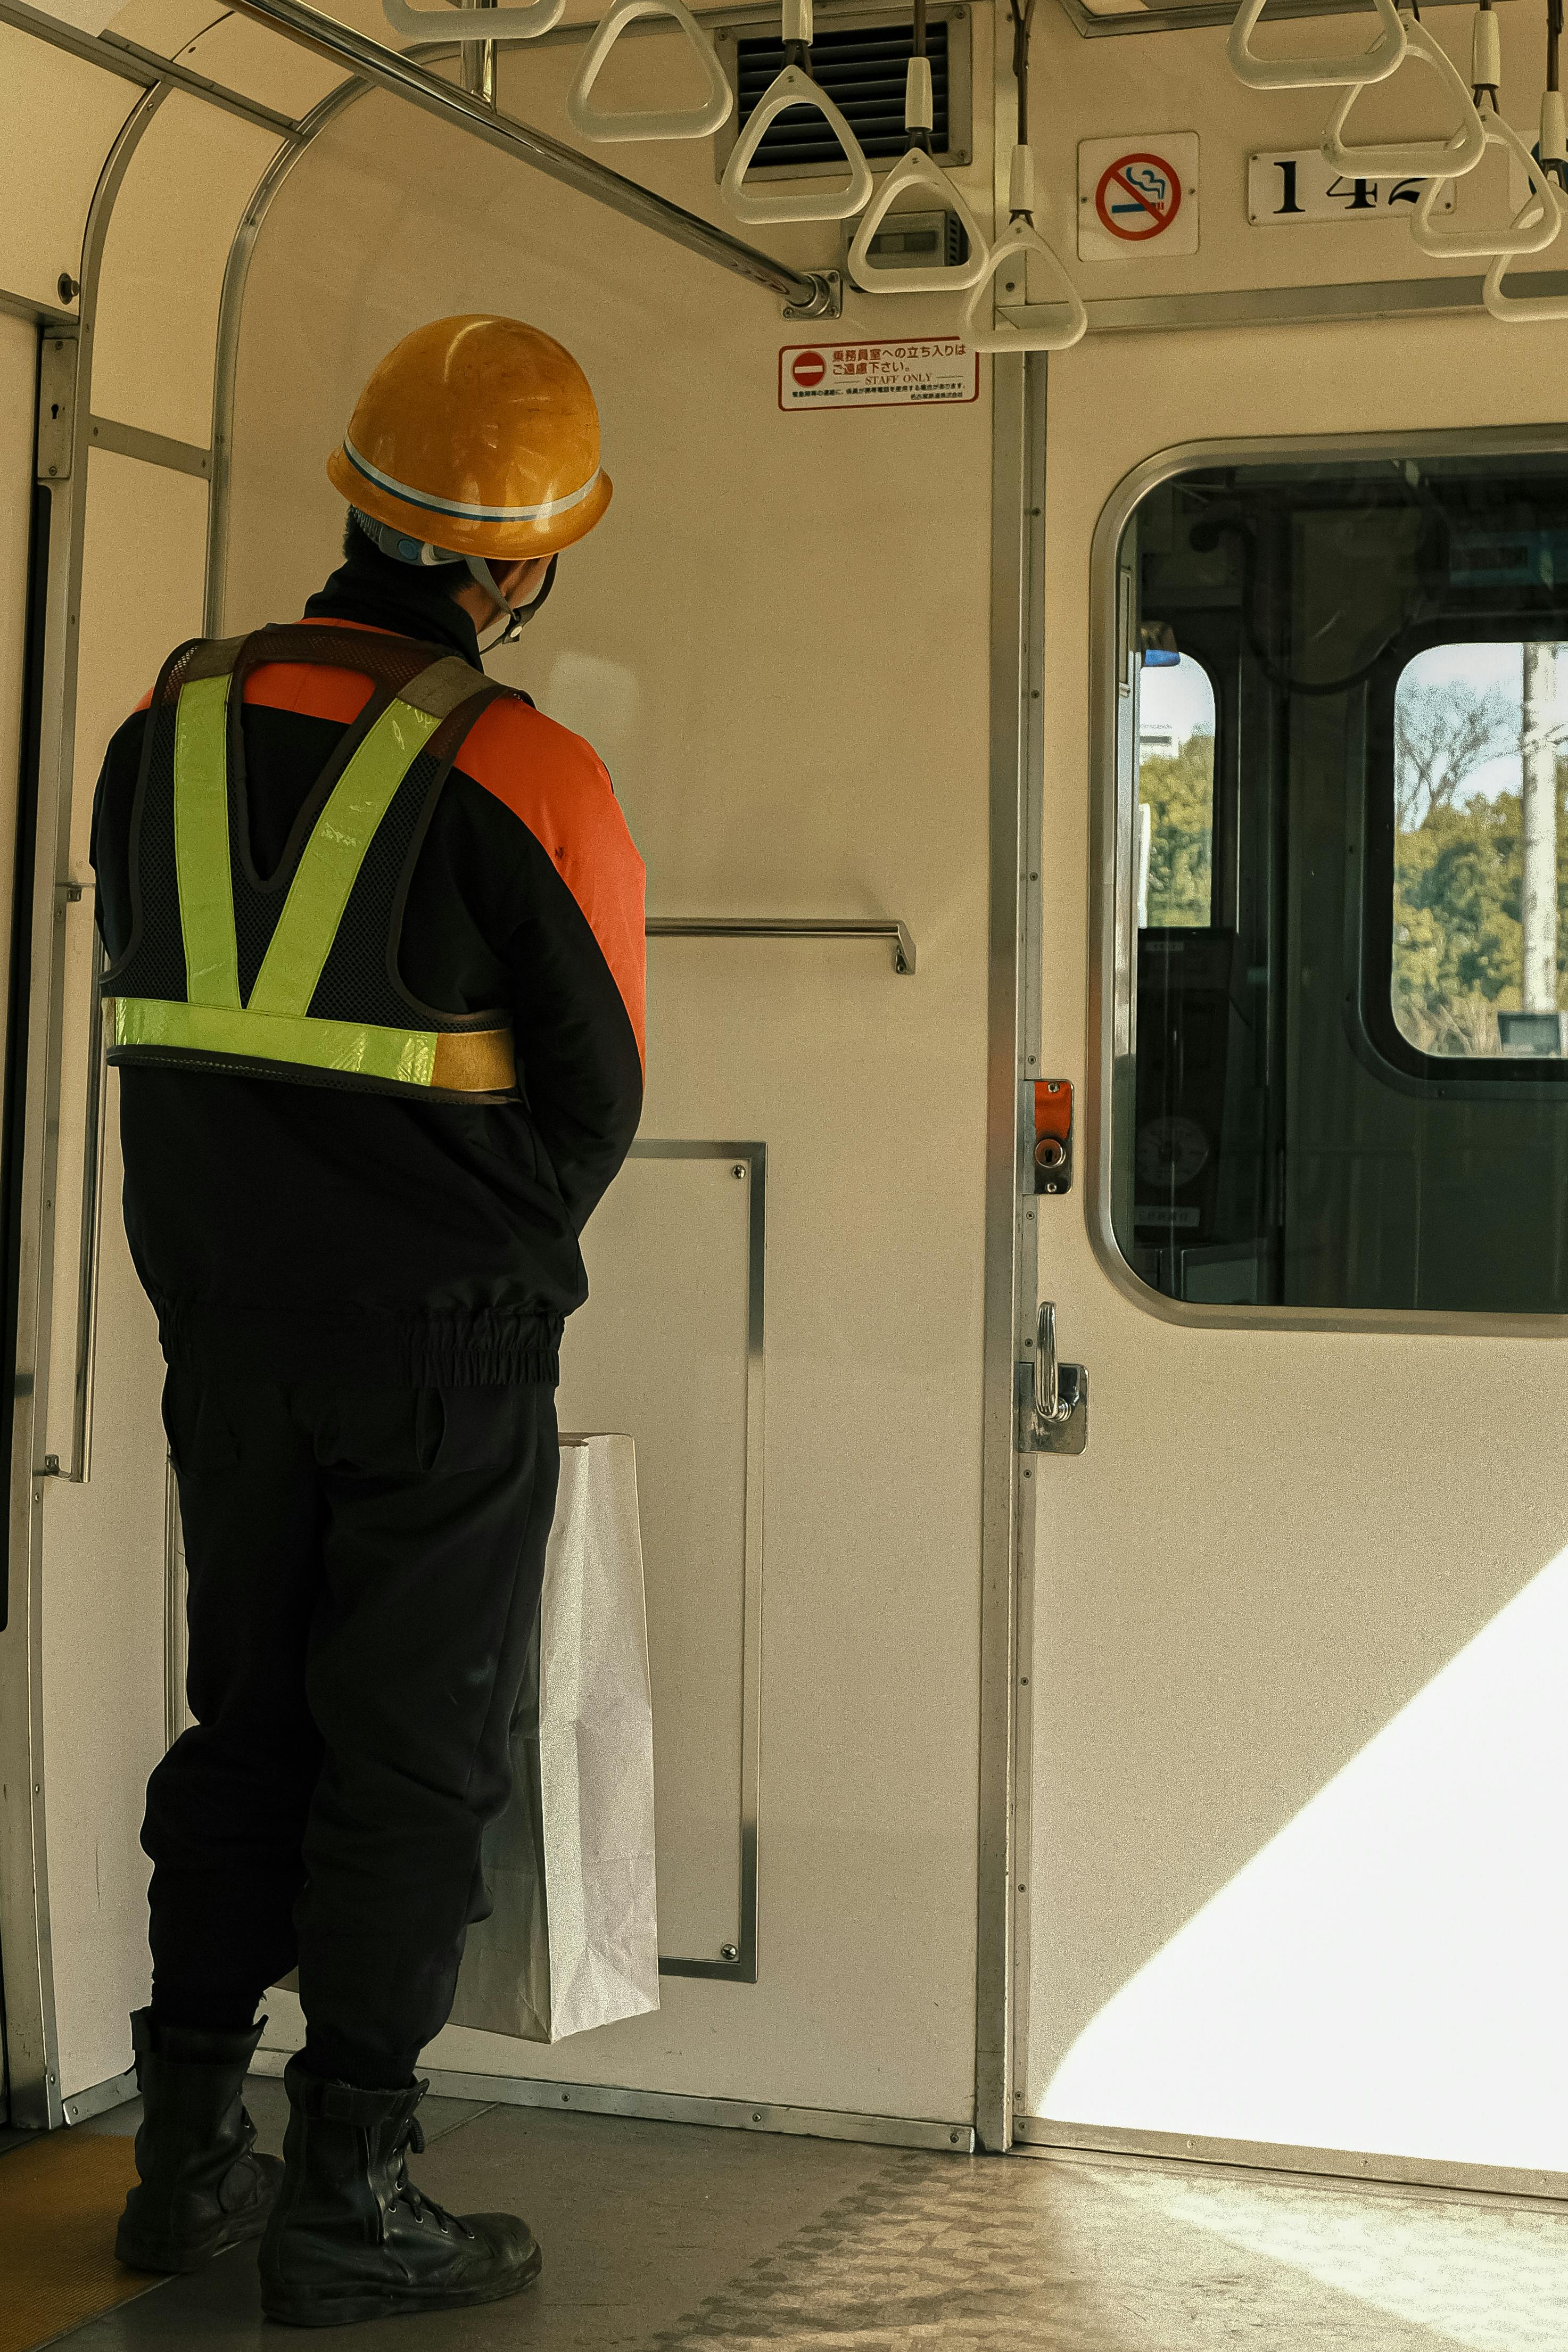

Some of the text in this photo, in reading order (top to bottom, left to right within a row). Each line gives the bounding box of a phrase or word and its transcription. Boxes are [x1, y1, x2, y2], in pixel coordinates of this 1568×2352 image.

[832, 344, 966, 362] 乗務員室への立ち入りは
[865, 373, 931, 384] STAFF ONLY
